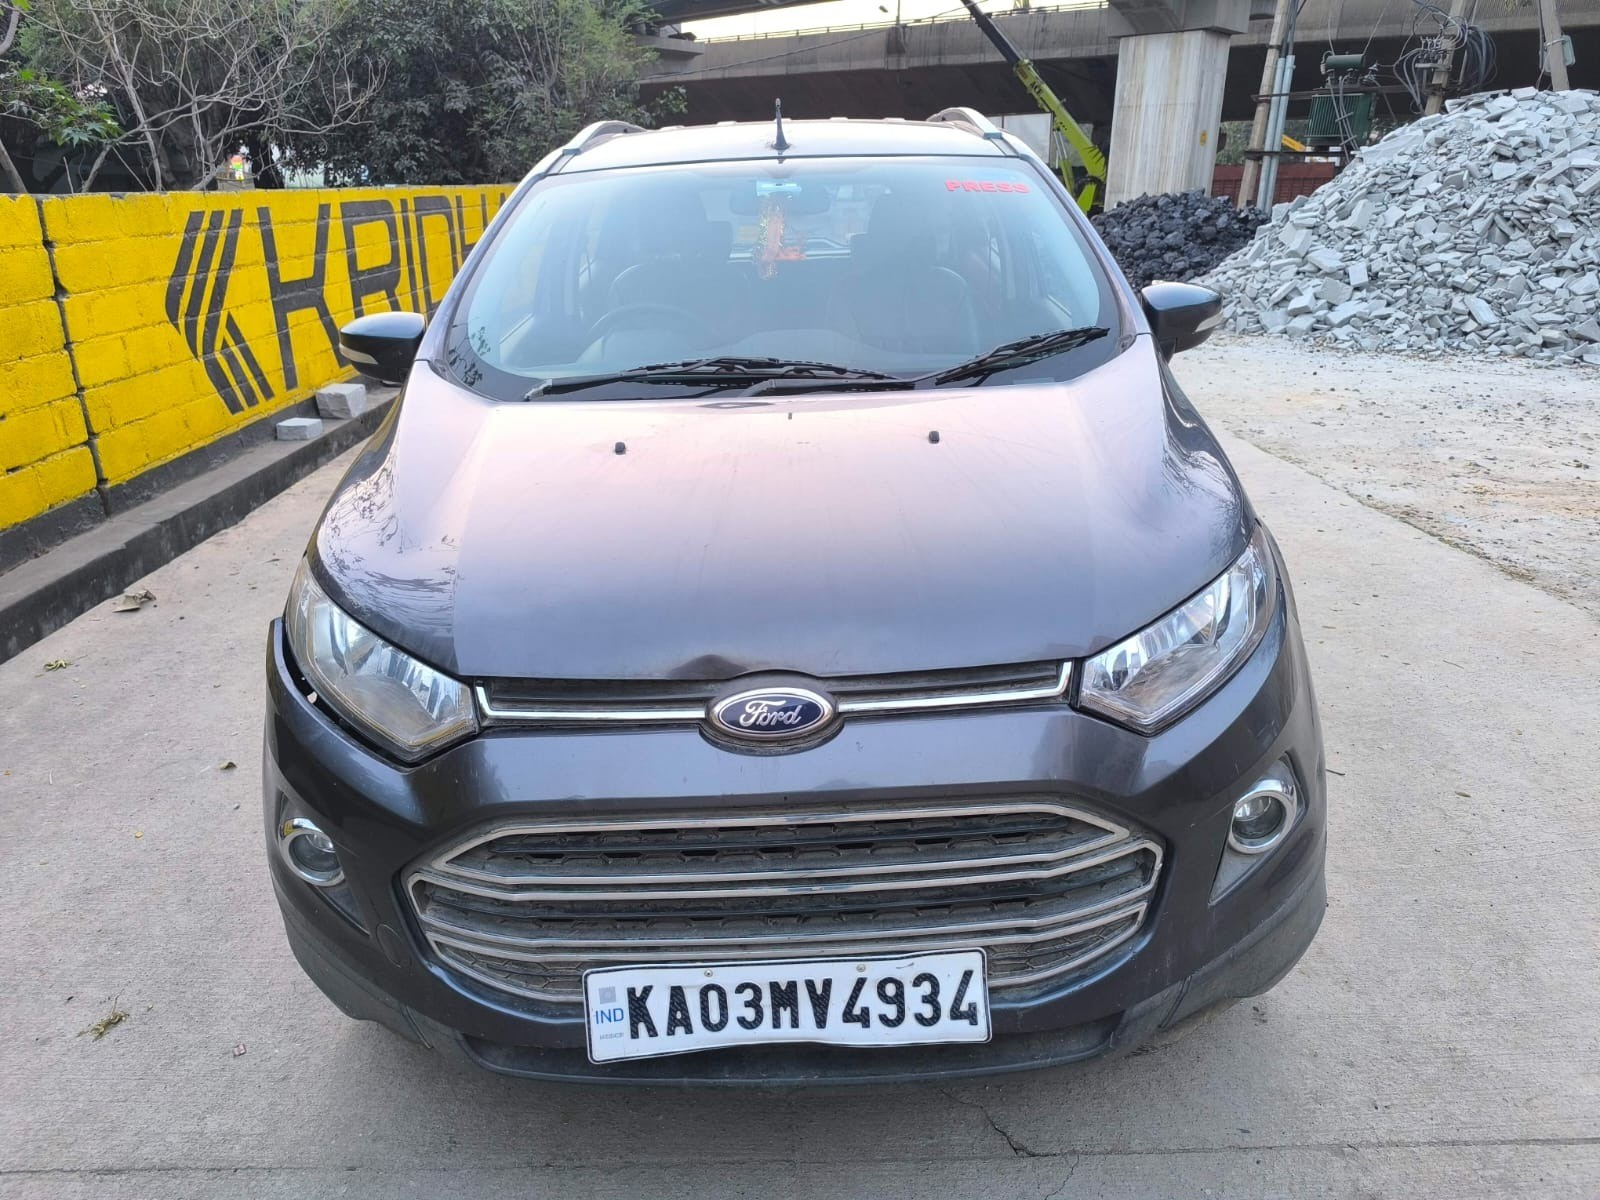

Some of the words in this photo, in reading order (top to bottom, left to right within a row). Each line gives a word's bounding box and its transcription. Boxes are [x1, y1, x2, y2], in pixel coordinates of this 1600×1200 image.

[945, 180, 1030, 193] PRESS
[256, 192, 507, 393] KRIDH
[739, 700, 801, 727] Ford
[595, 1007, 624, 1025] IND
[626, 969, 979, 1040] KA03MV4934
